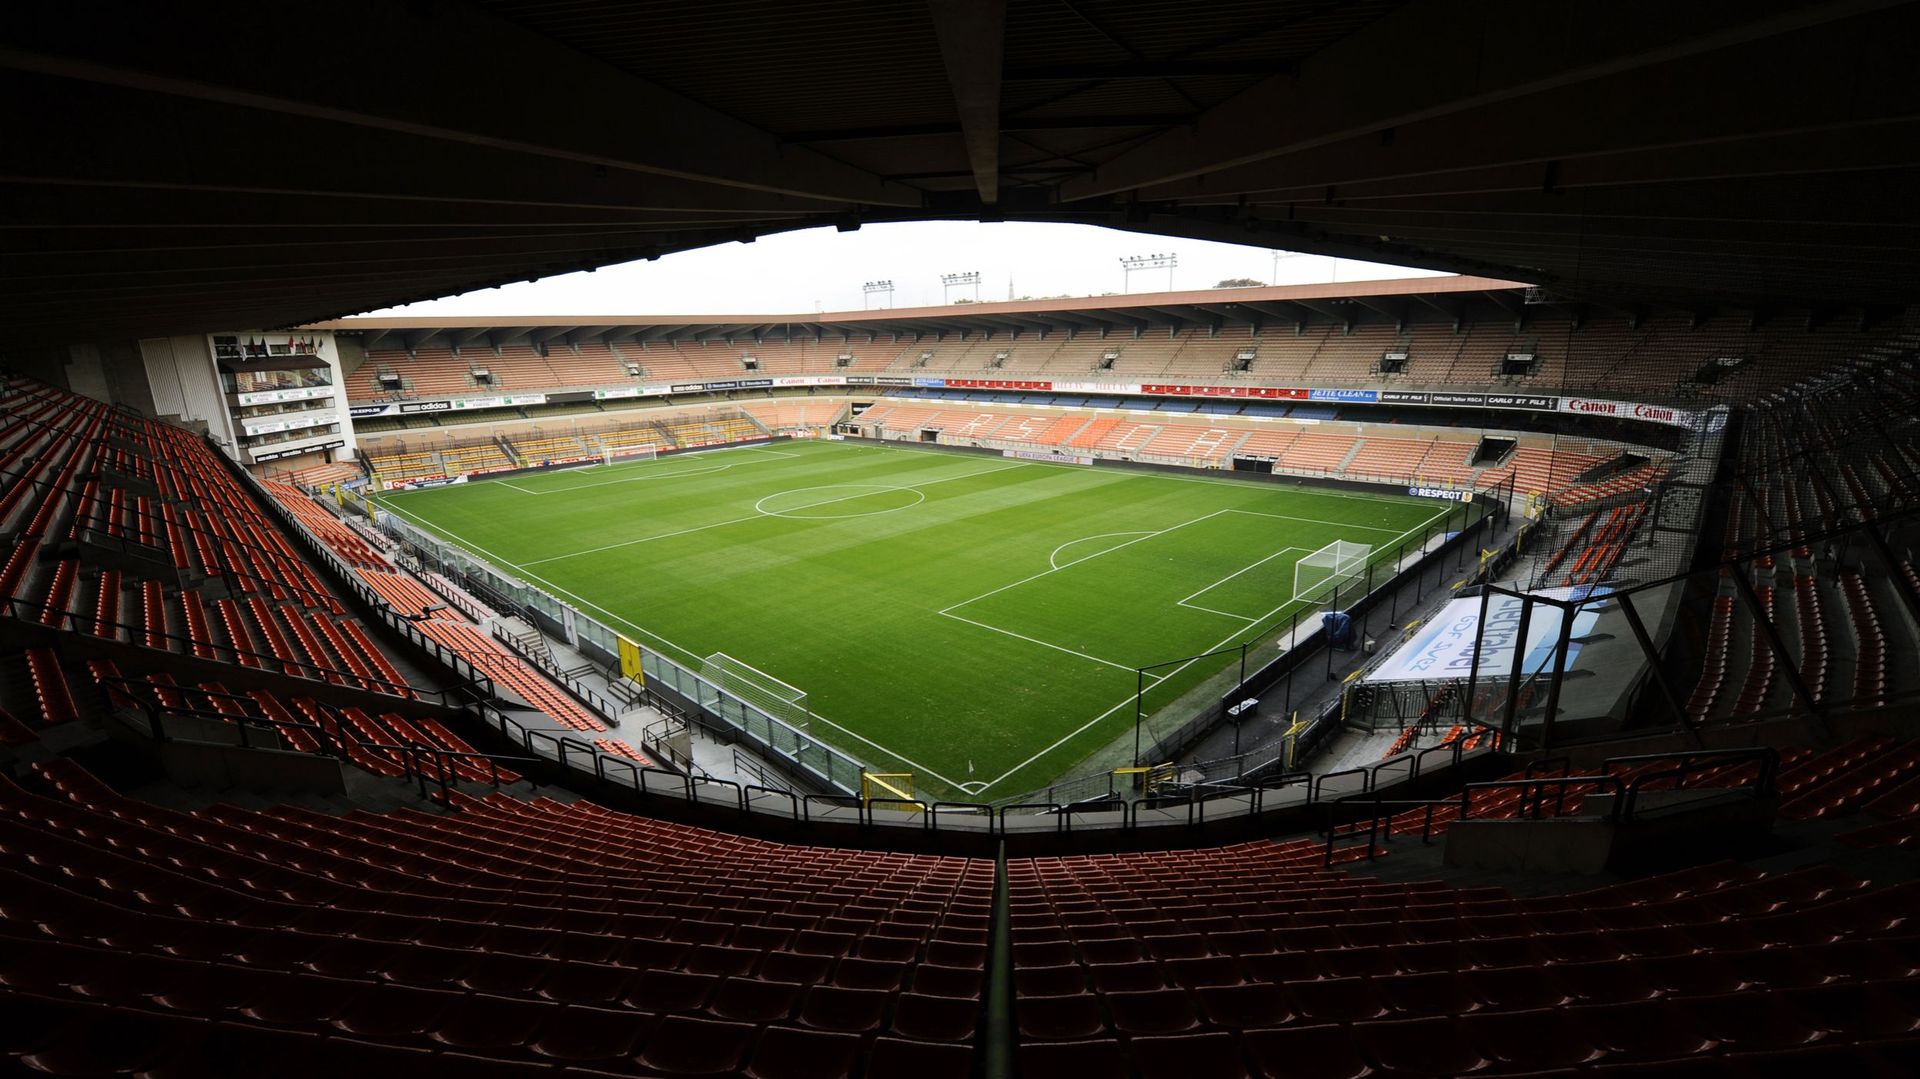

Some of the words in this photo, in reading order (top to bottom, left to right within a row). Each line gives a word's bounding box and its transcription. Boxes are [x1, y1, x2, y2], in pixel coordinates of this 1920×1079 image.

[1337, 390, 1364, 398] CLEAN
[420, 402, 448, 410] adidas
[1569, 399, 1617, 414] Canon
[1635, 405, 1674, 421] Canon
[1418, 488, 1461, 500] RESPECT
[1448, 615, 1478, 640] GDF
